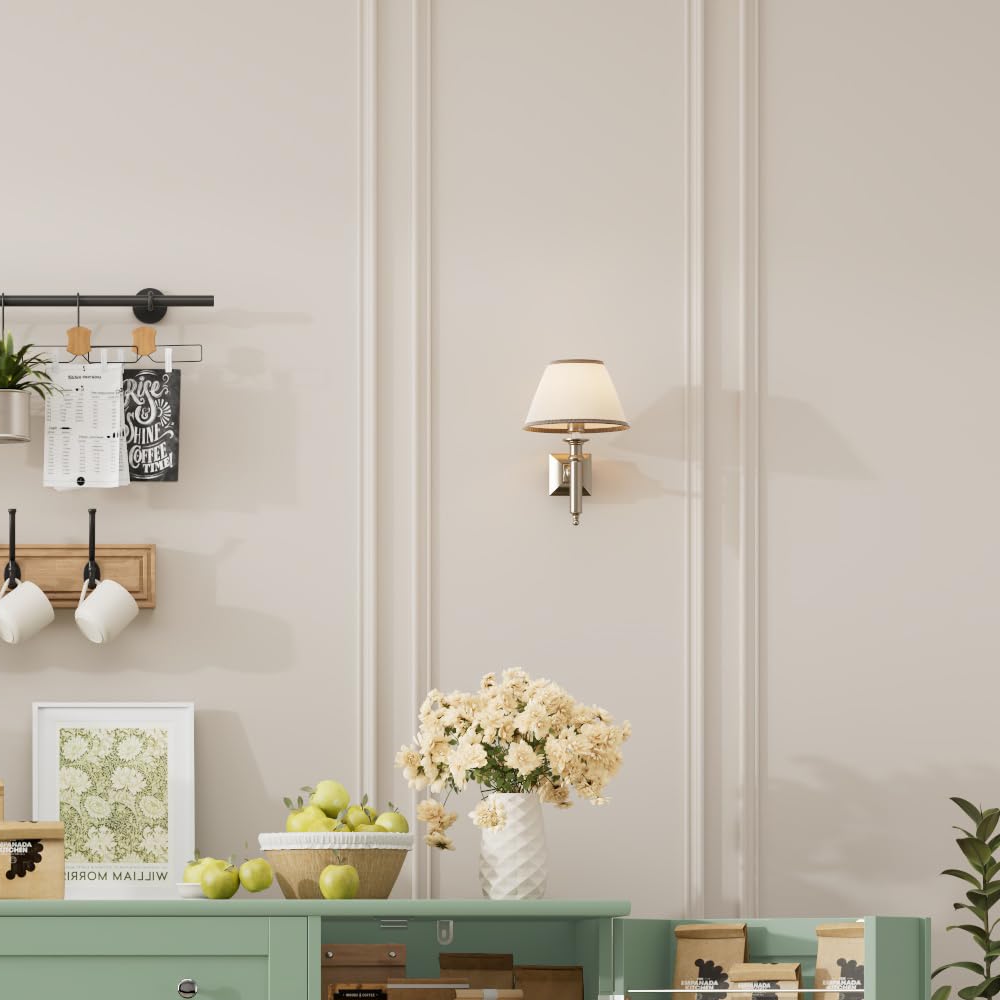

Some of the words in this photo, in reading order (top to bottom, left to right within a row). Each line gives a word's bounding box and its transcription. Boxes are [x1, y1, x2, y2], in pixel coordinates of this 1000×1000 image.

[123, 375, 169, 421] Rise
[140, 408, 148, 420] &
[129, 442, 167, 468] COFFEE
[143, 452, 173, 473] TIME!
